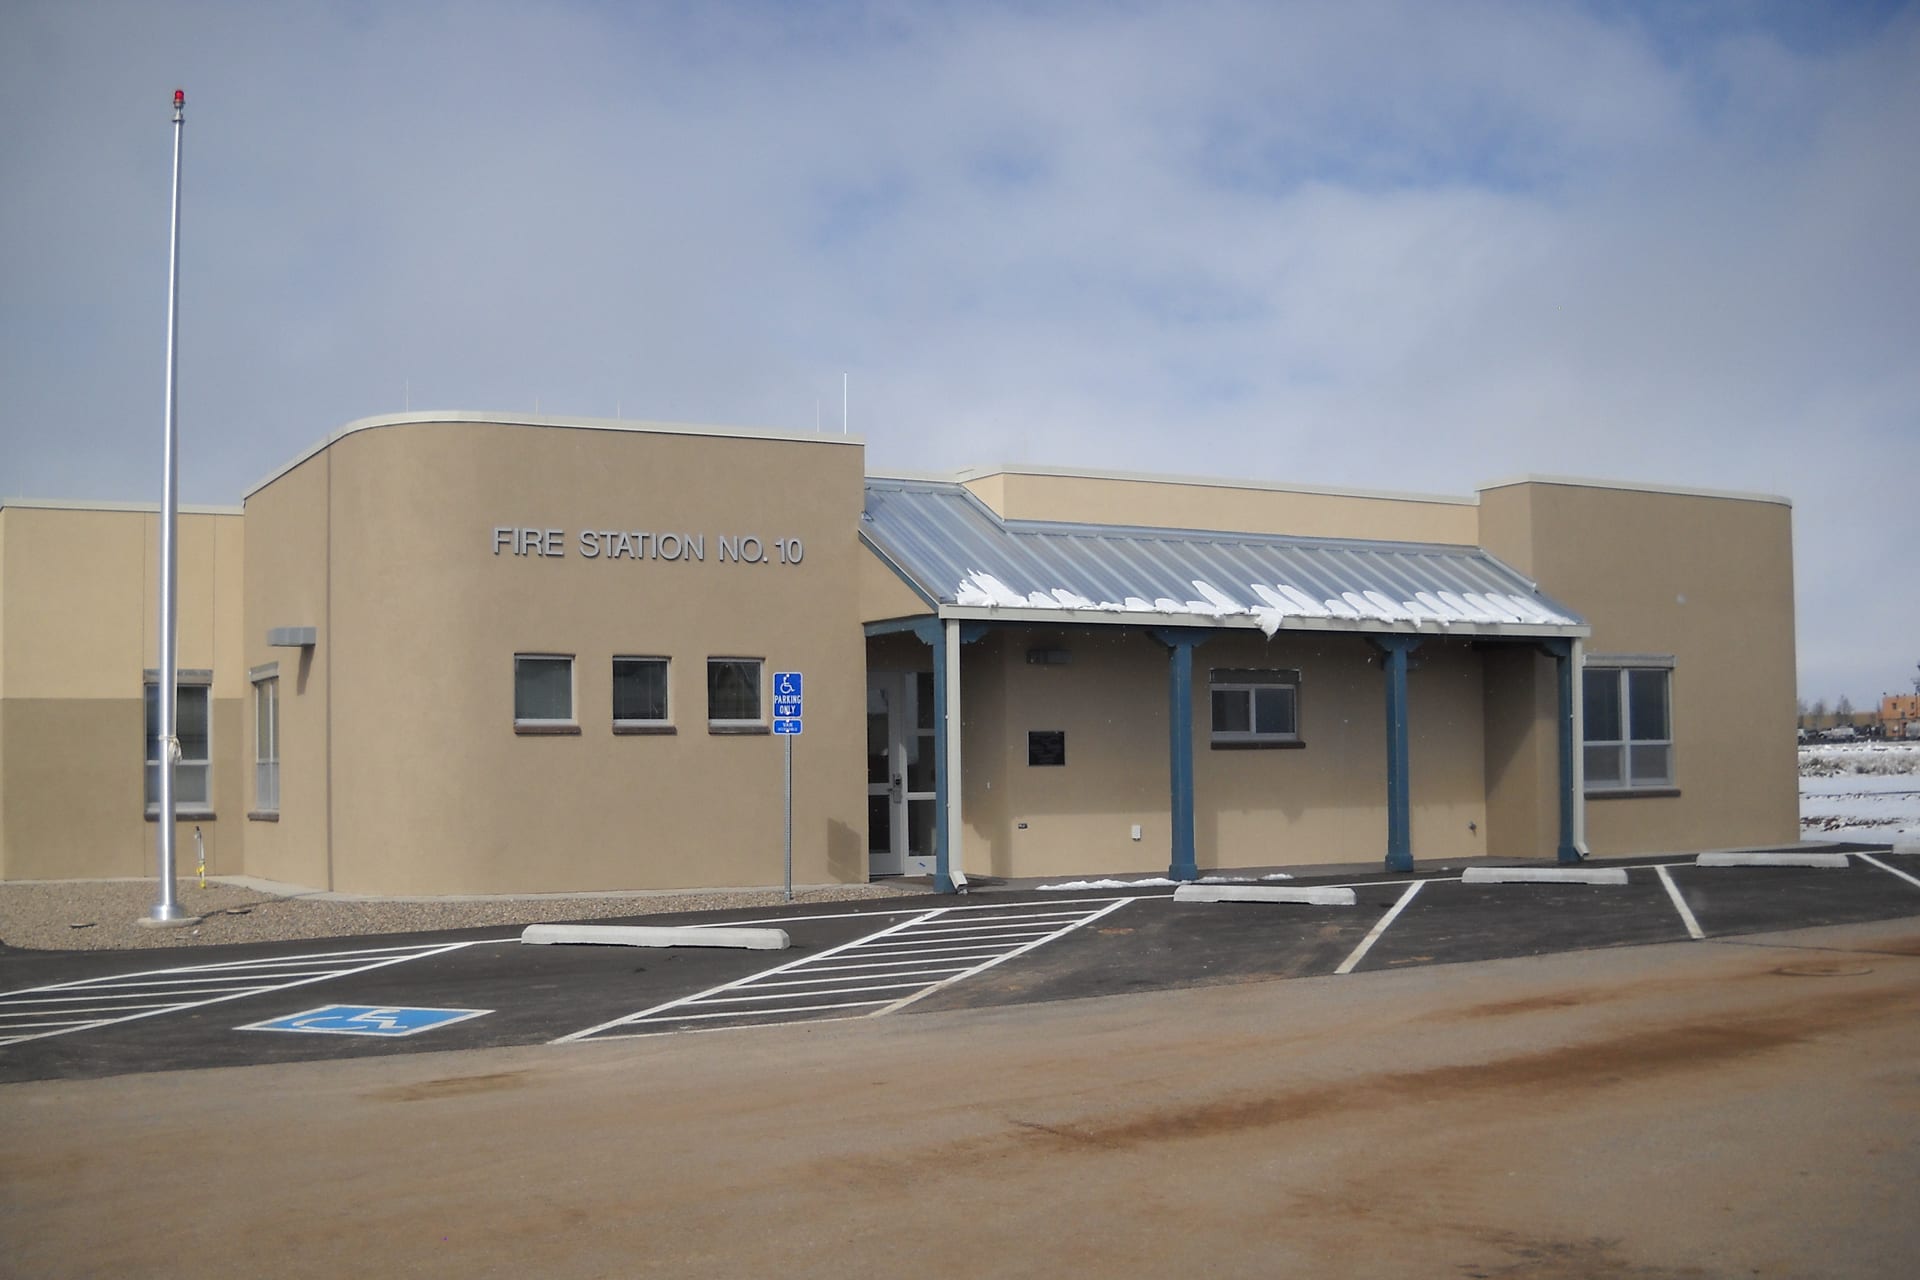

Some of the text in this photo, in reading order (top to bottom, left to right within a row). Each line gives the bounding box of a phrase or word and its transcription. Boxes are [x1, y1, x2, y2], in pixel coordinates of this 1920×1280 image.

[493, 527, 804, 565] FIRE STATION NO. 10
[774, 695, 801, 704] PARKING
[779, 705, 796, 714] ONLY
